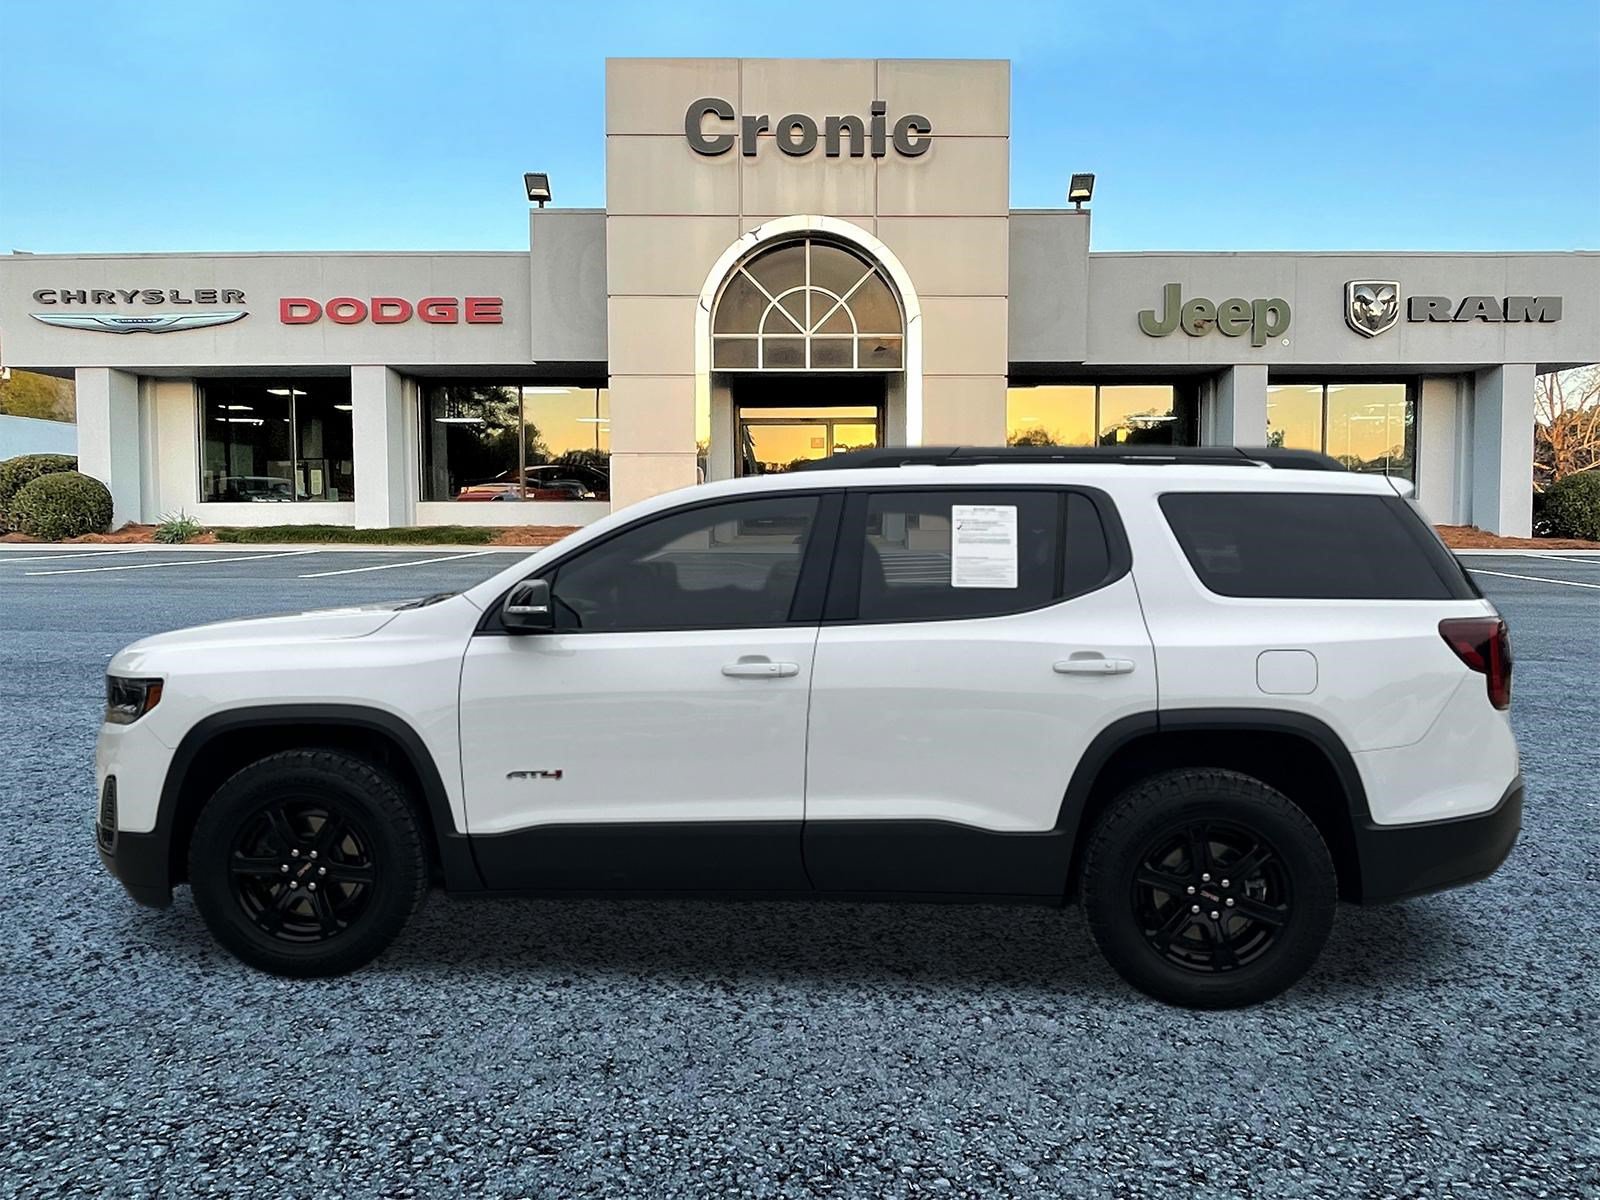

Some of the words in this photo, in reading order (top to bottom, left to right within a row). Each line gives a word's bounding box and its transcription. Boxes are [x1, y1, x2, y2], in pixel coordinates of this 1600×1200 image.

[685, 97, 932, 157] Cronic
[32, 289, 247, 304] CHRYSLER
[1407, 296, 1562, 322] RAM
[279, 297, 503, 325] DODGE
[1138, 283, 1291, 347] Jeep
[506, 769, 563, 780] AT4
